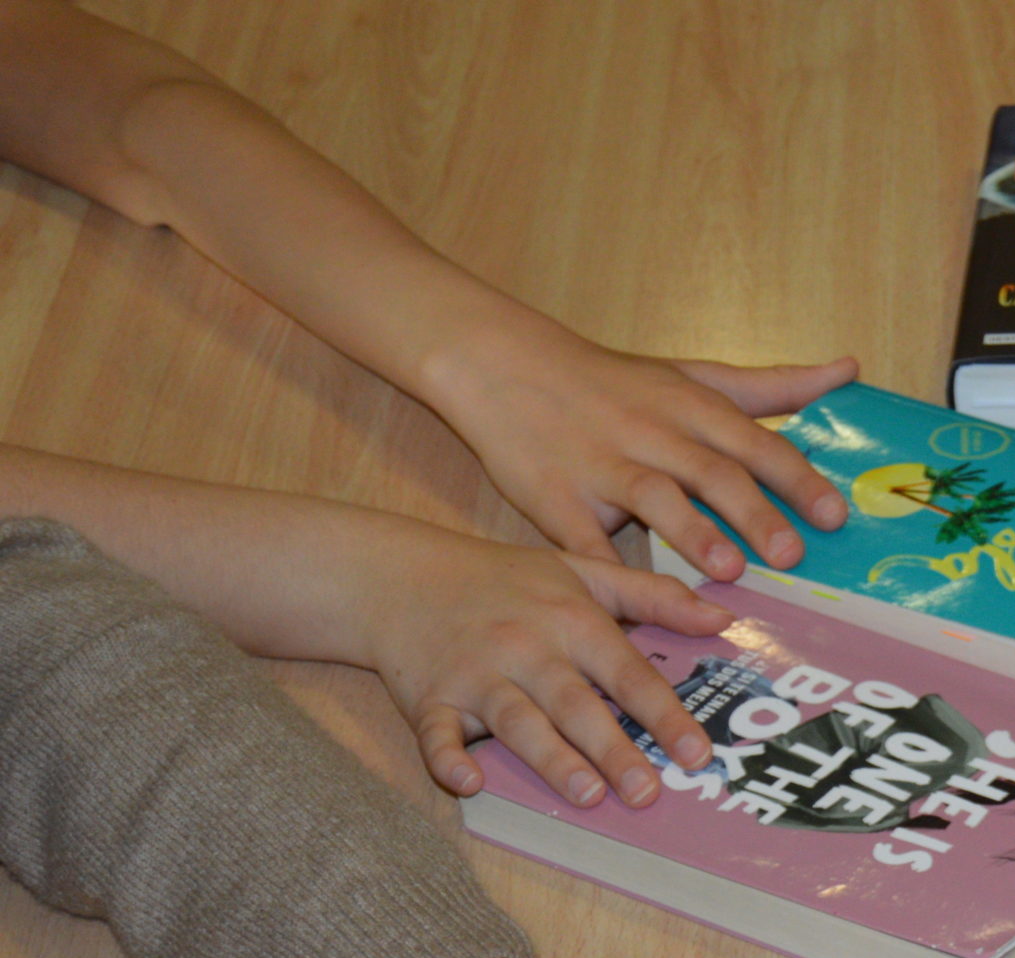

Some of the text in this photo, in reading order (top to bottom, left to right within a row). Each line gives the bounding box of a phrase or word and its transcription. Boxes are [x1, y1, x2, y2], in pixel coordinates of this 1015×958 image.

[708, 666, 738, 688] DOS
[722, 681, 745, 697] TE
[659, 664, 853, 802] BOYS
[716, 679, 919, 827] OF THE
[813, 731, 954, 826] ONE
[872, 826, 955, 873] IS
